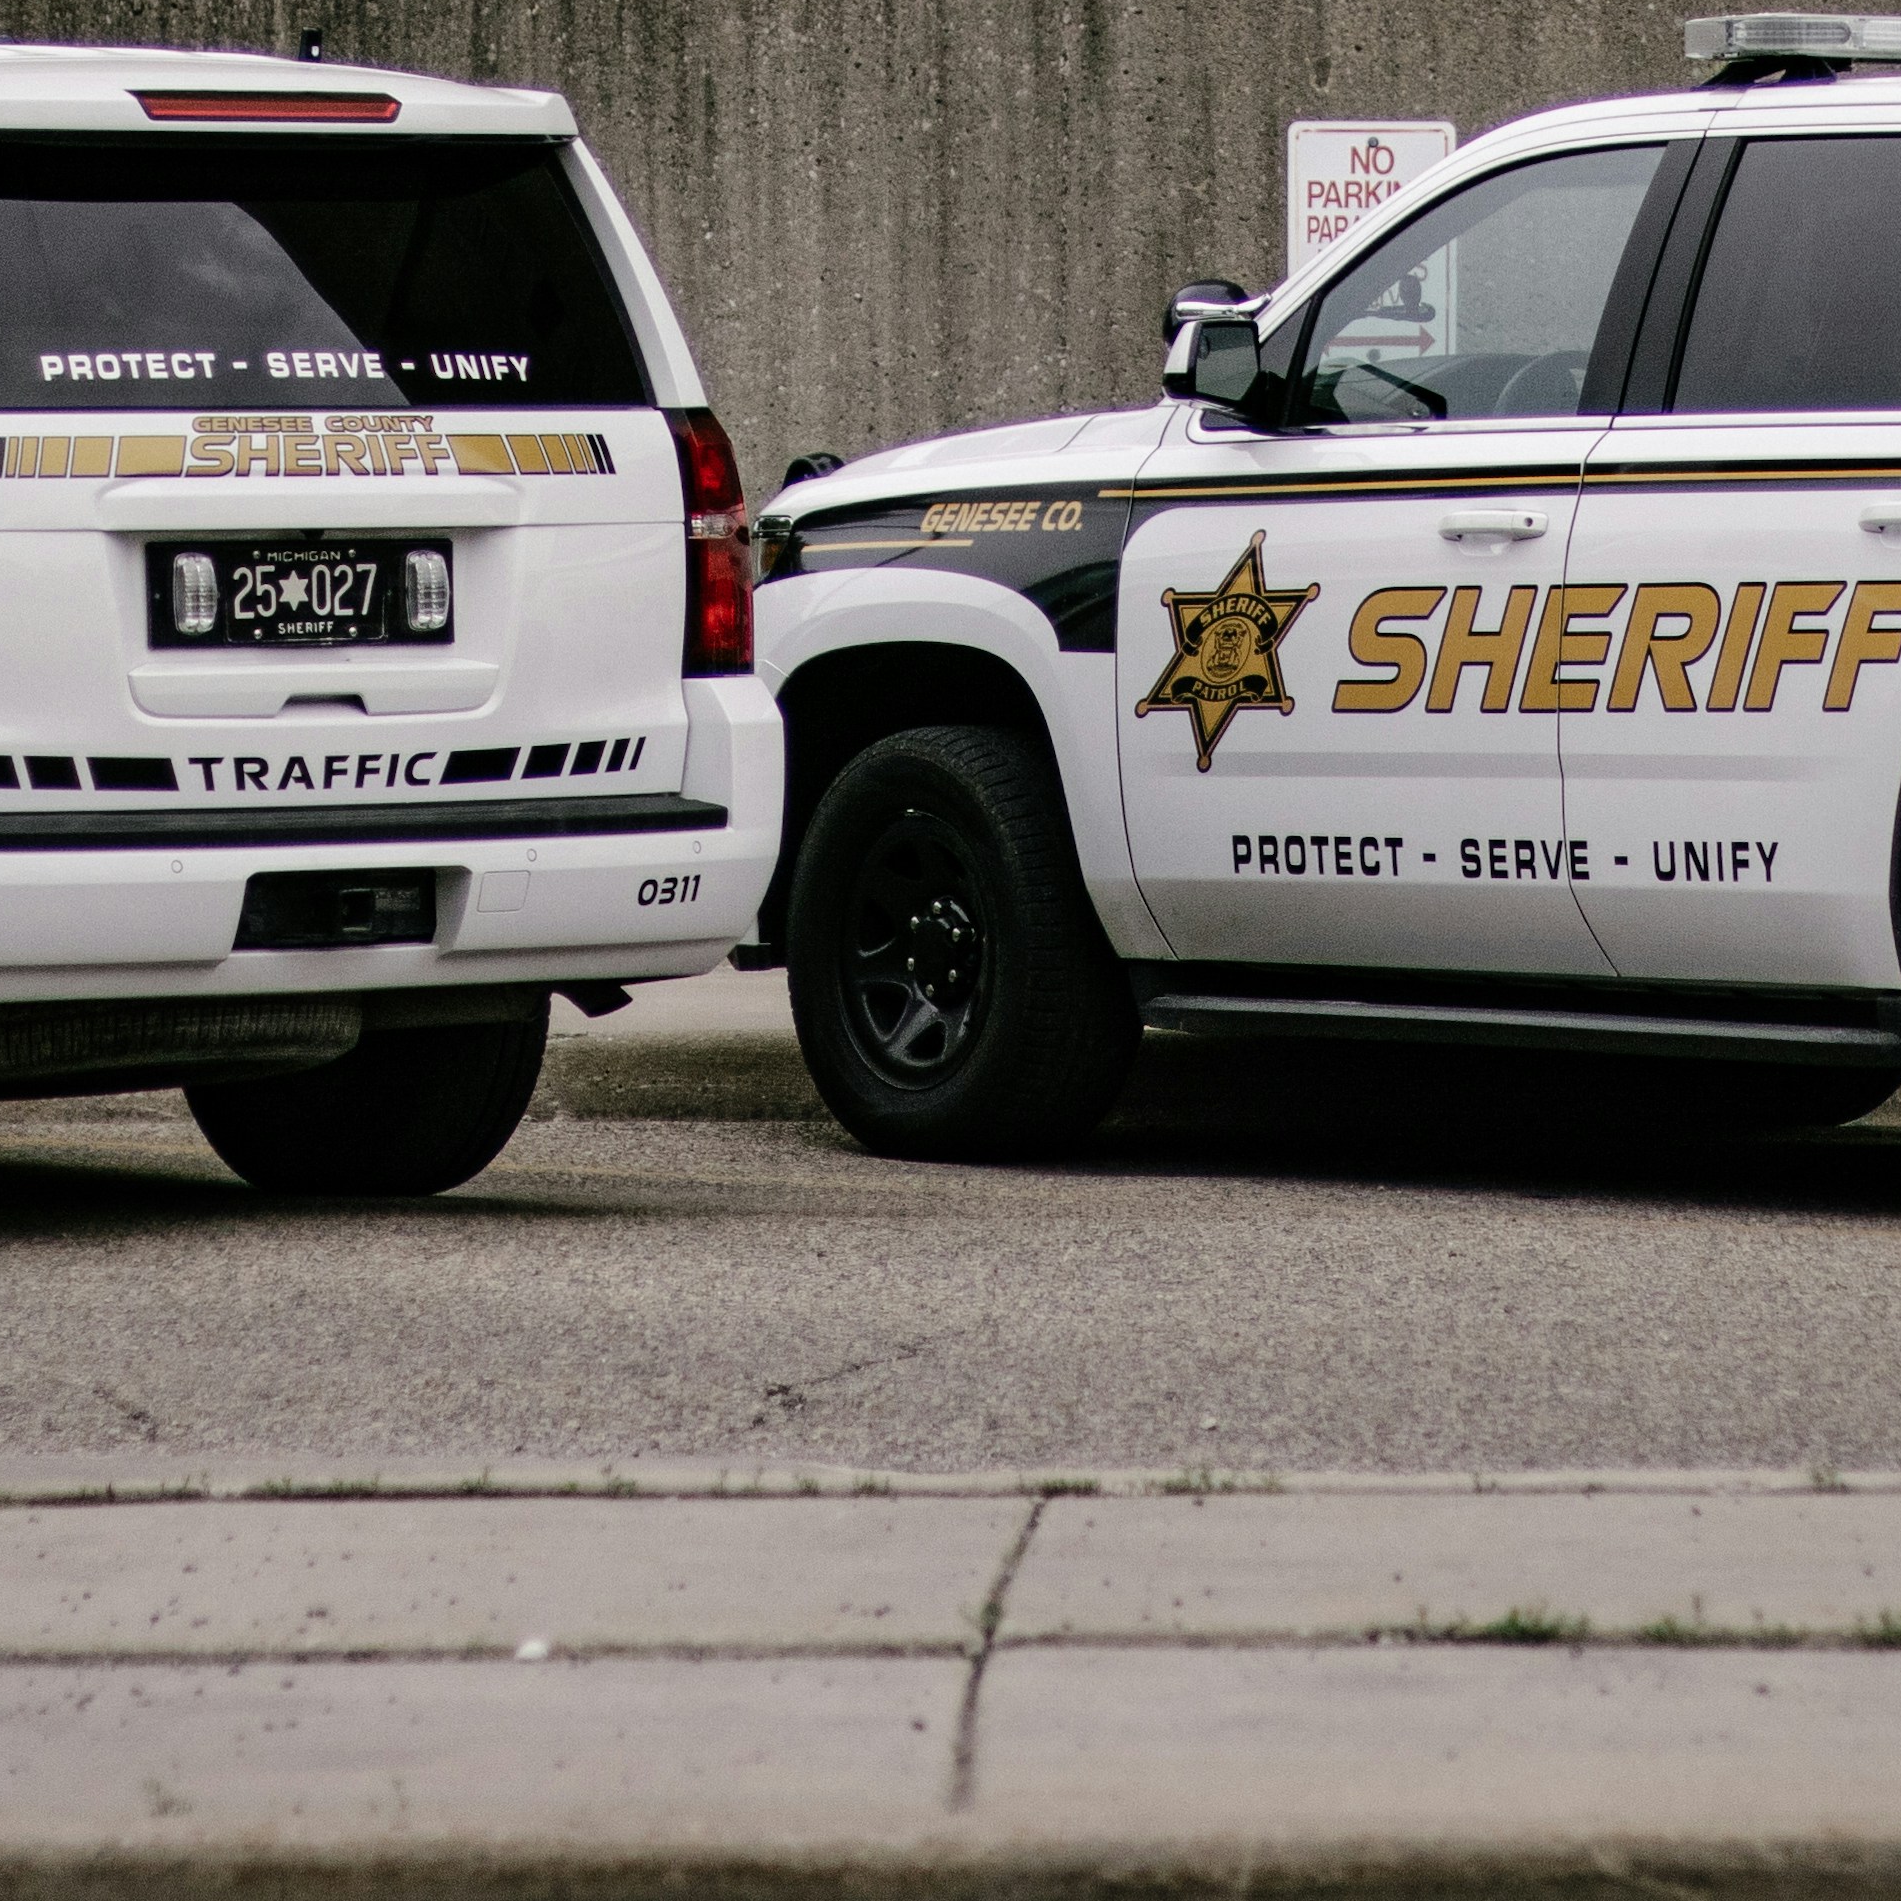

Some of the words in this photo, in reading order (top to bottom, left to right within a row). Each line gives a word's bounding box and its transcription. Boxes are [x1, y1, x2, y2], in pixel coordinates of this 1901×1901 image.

[1350, 146, 1395, 175] NO
[1307, 180, 1410, 208] PARKI
[40, 352, 218, 381] PROTECT
[267, 352, 385, 380] SERVE
[430, 354, 529, 382] UNIFY
[192, 416, 313, 433] GENESEE
[324, 415, 434, 433] COUNTY
[184, 434, 452, 477] SHERIFF
[920, 501, 1042, 533] GENESEE
[1041, 500, 1083, 531] CO.
[267, 551, 341, 562] MICHIGAN
[232, 565, 277, 619] 25
[311, 563, 377, 616] 027
[1200, 597, 1271, 627] SHERIFF
[277, 621, 335, 635] SHERIFF
[1193, 681, 1248, 700] PATROL
[188, 751, 439, 791] TRAFFIC
[1231, 834, 1403, 876] PROTECT
[1461, 837, 1591, 880] SERVE
[1653, 841, 1779, 882] UNIFY
[637, 874, 702, 906] 0311
